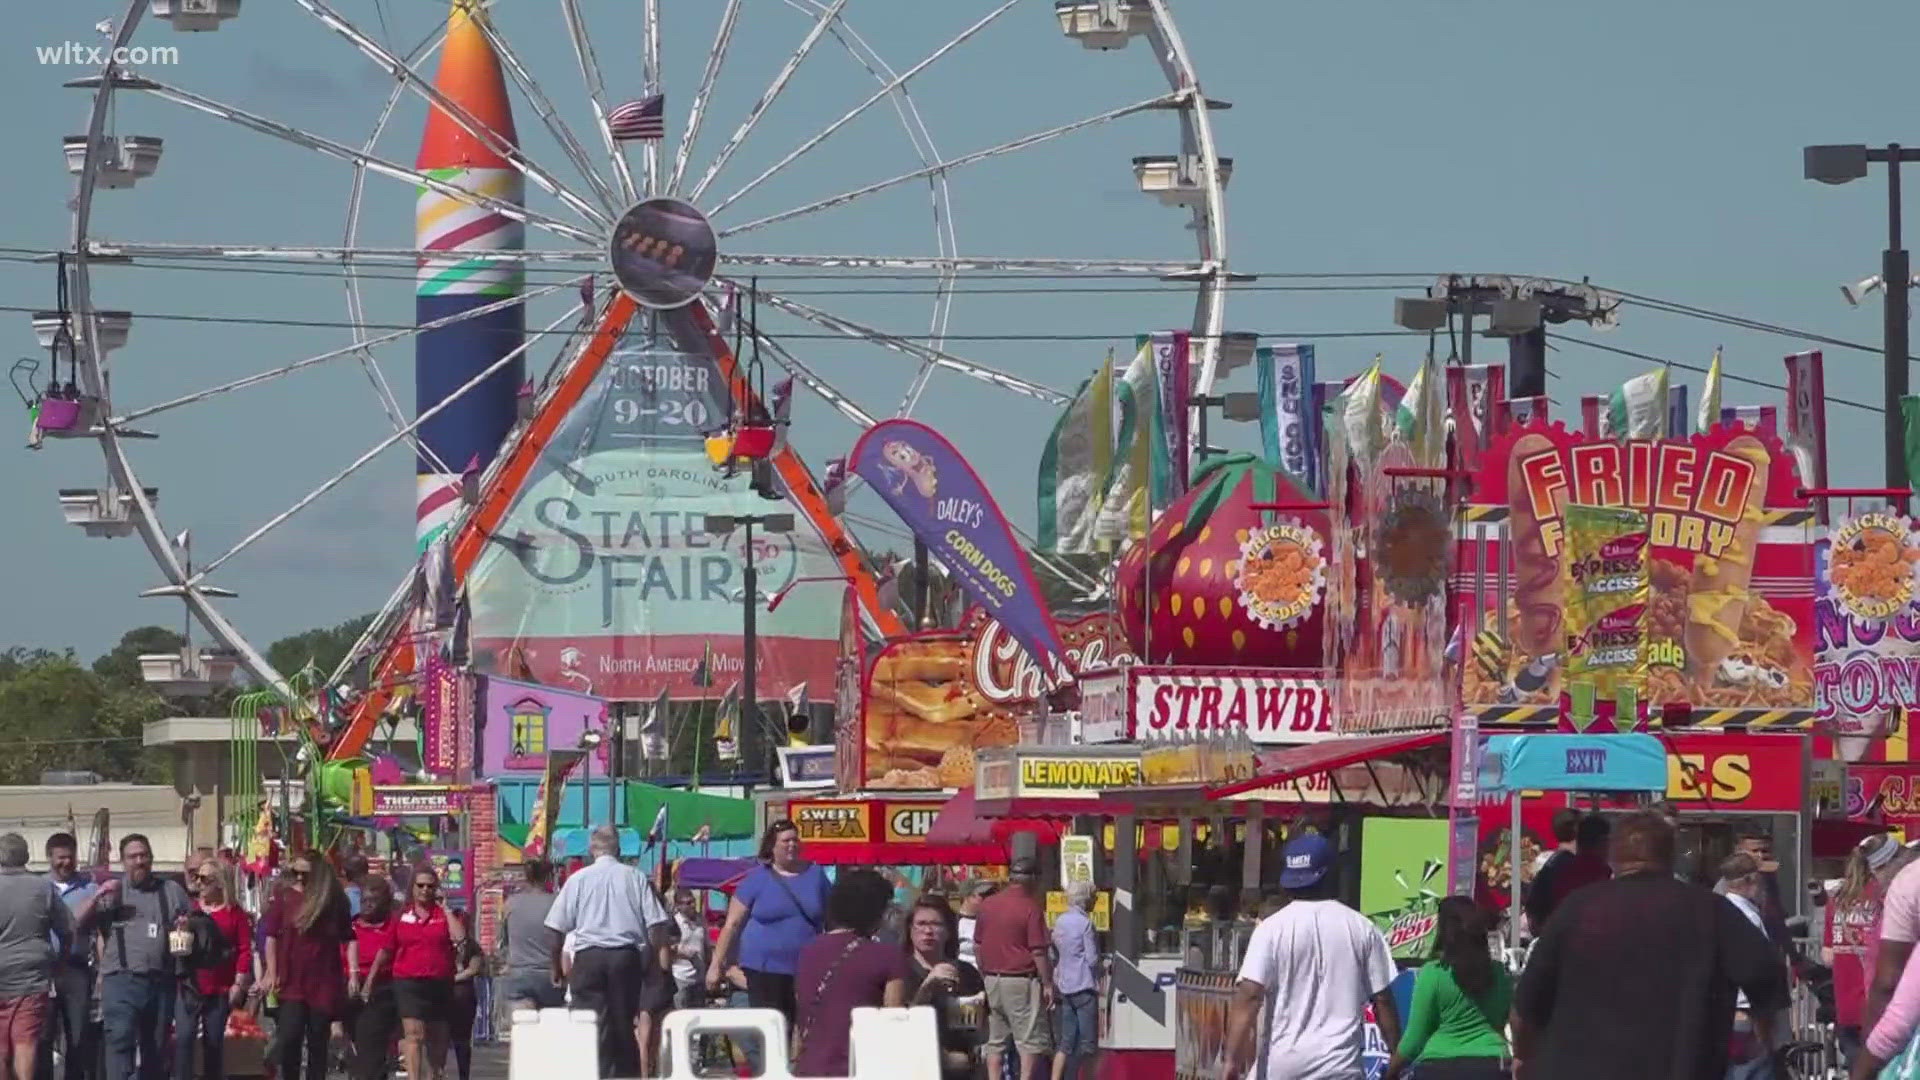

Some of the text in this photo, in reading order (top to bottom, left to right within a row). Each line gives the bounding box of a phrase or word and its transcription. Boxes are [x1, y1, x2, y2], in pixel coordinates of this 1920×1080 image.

[610, 365, 709, 392] OCTOBER
[614, 399, 708, 426] 9-20
[647, 467, 730, 493] CAROLINA
[1522, 443, 1755, 523] FRIED
[937, 497, 984, 529] DALEY'S
[519, 496, 711, 585] STATE
[1540, 513, 1735, 559] FORY
[945, 529, 985, 567] CORN
[979, 559, 1017, 597] DOGS
[1571, 554, 1643, 584] EXPRESS
[599, 555, 733, 629] FAIR
[1587, 577, 1640, 593] ACCESS
[1567, 625, 1639, 656] EXPRESS
[645, 654, 706, 673] AMERICA
[1587, 649, 1637, 665] ACCESS
[1022, 760, 1138, 789] LEMONADE
[1565, 749, 1607, 775] EXIT
[383, 796, 448, 805] THEATER
[800, 808, 859, 821] SWEET
[797, 817, 866, 838] TEA
[892, 808, 942, 837] CH
